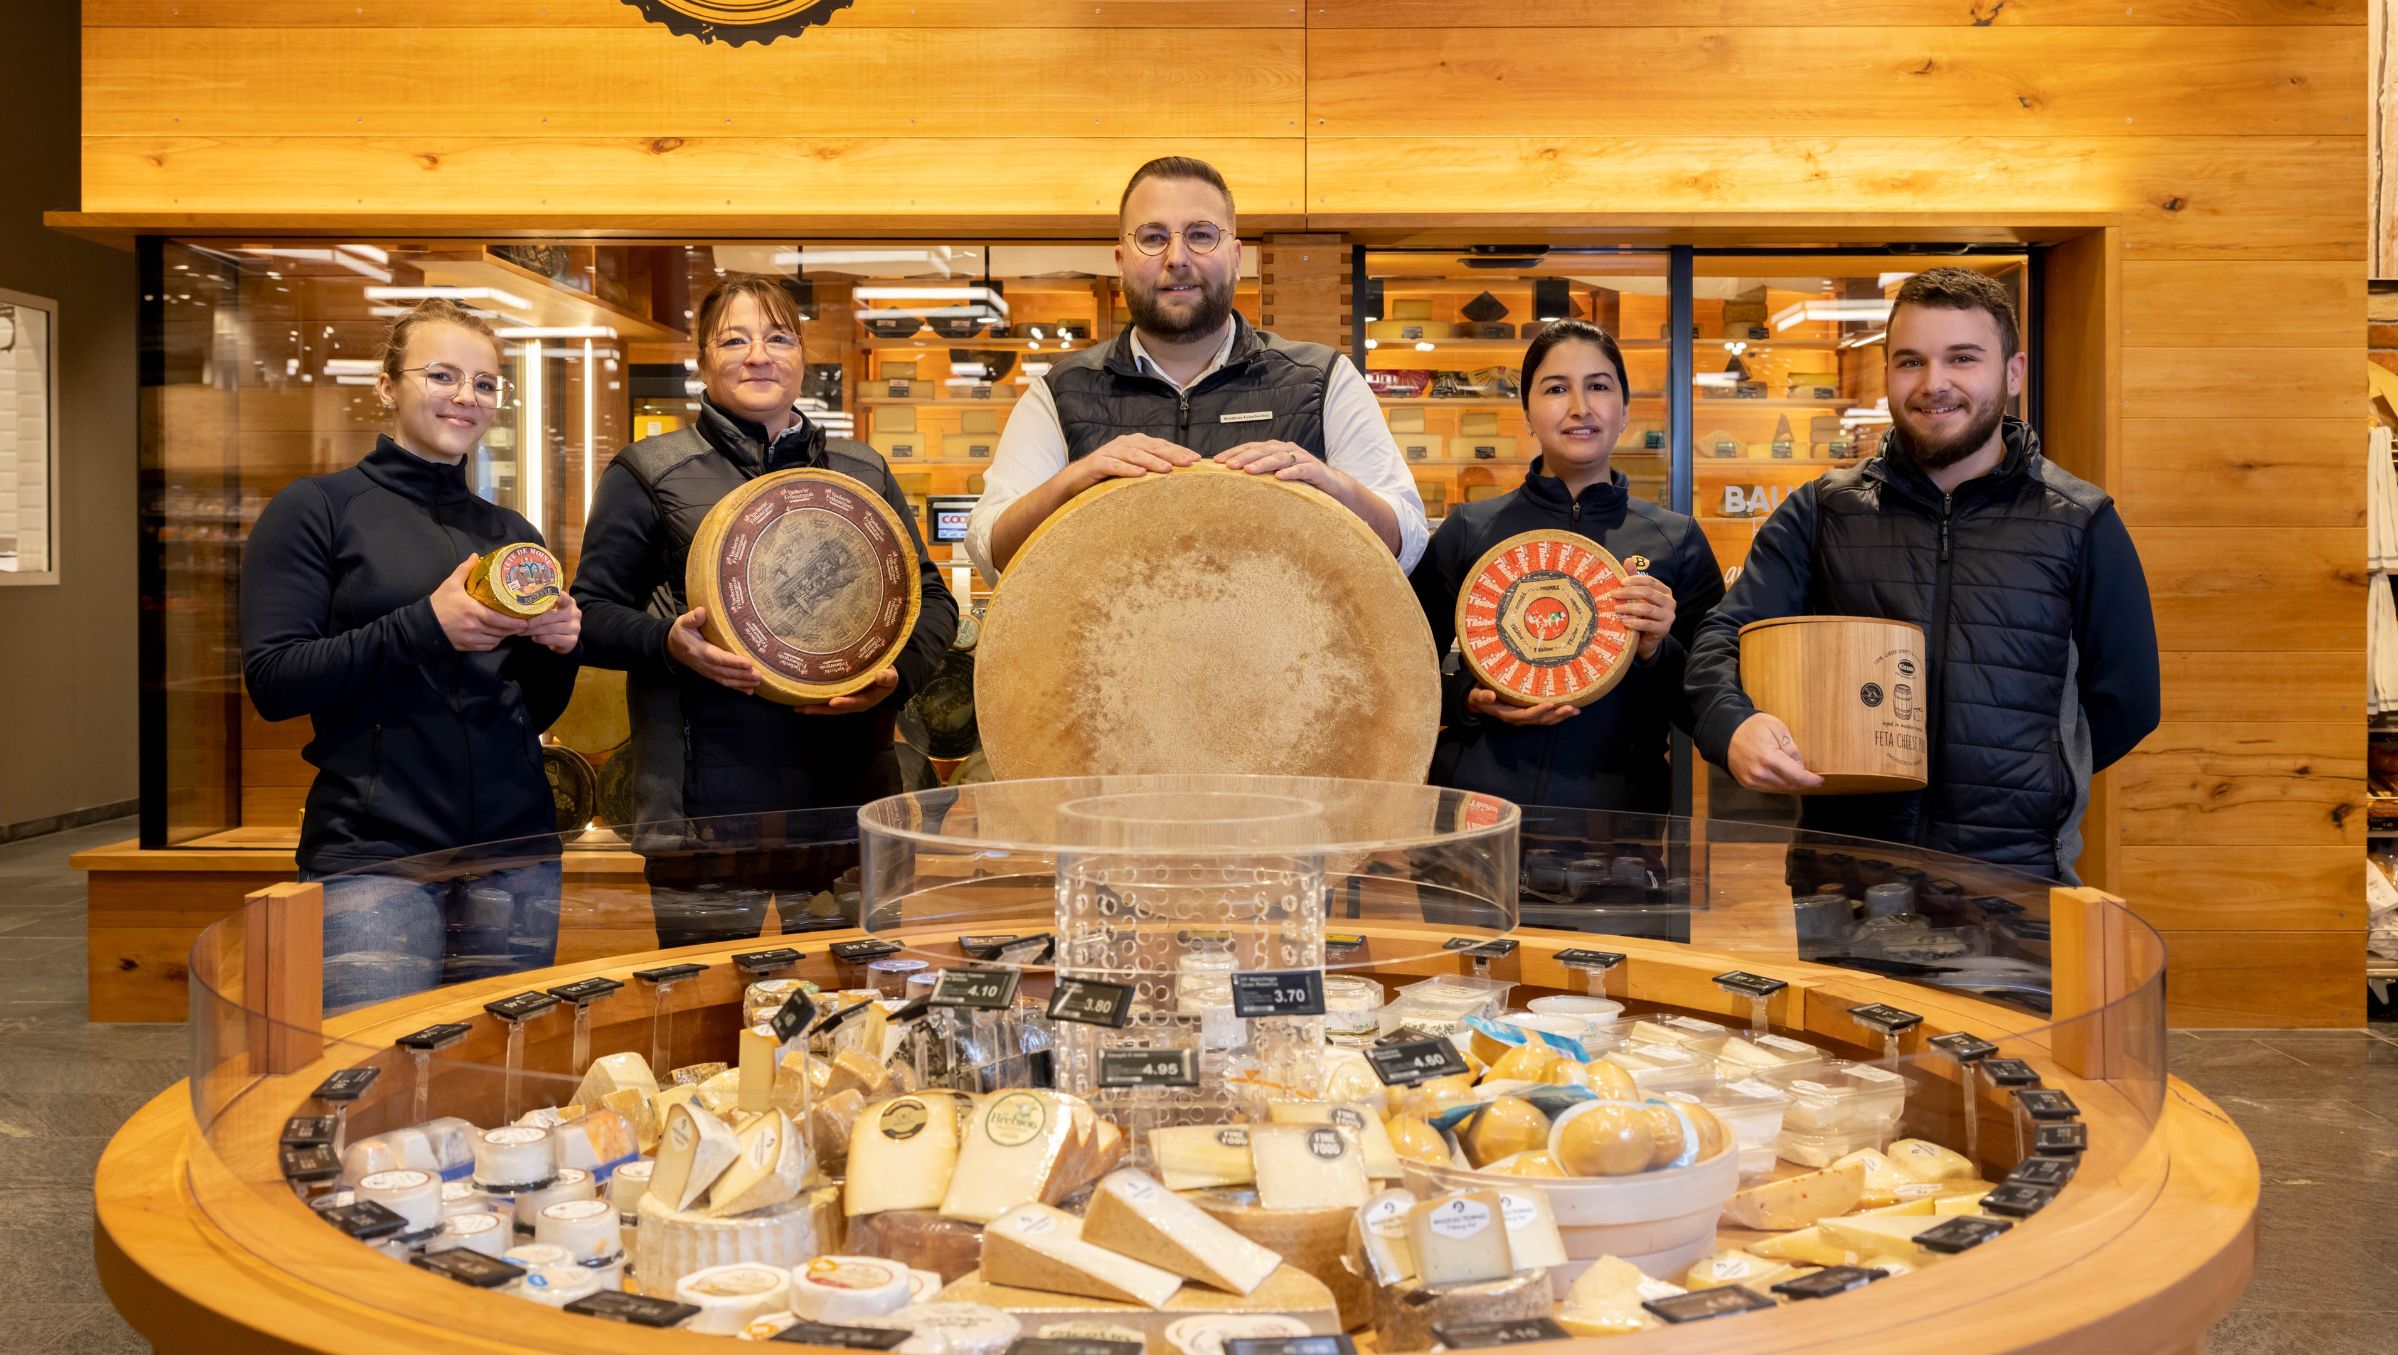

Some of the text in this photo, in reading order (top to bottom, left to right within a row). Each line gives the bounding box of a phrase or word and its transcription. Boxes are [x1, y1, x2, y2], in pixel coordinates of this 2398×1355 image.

[517, 547, 528, 555] DE
[530, 548, 551, 567] MOINE
[1875, 731, 1894, 747] FETA
[1897, 733, 1918, 752] CHEESE
[968, 985, 998, 997] 4.10
[1274, 989, 1306, 1003] 3.70
[1083, 998, 1112, 1013] 3.80
[1142, 1063, 1178, 1075] 4.95
[1221, 1136, 1248, 1145] FOOD
[1315, 1133, 1335, 1142] FINE
[1313, 1143, 1340, 1154] FOOD
